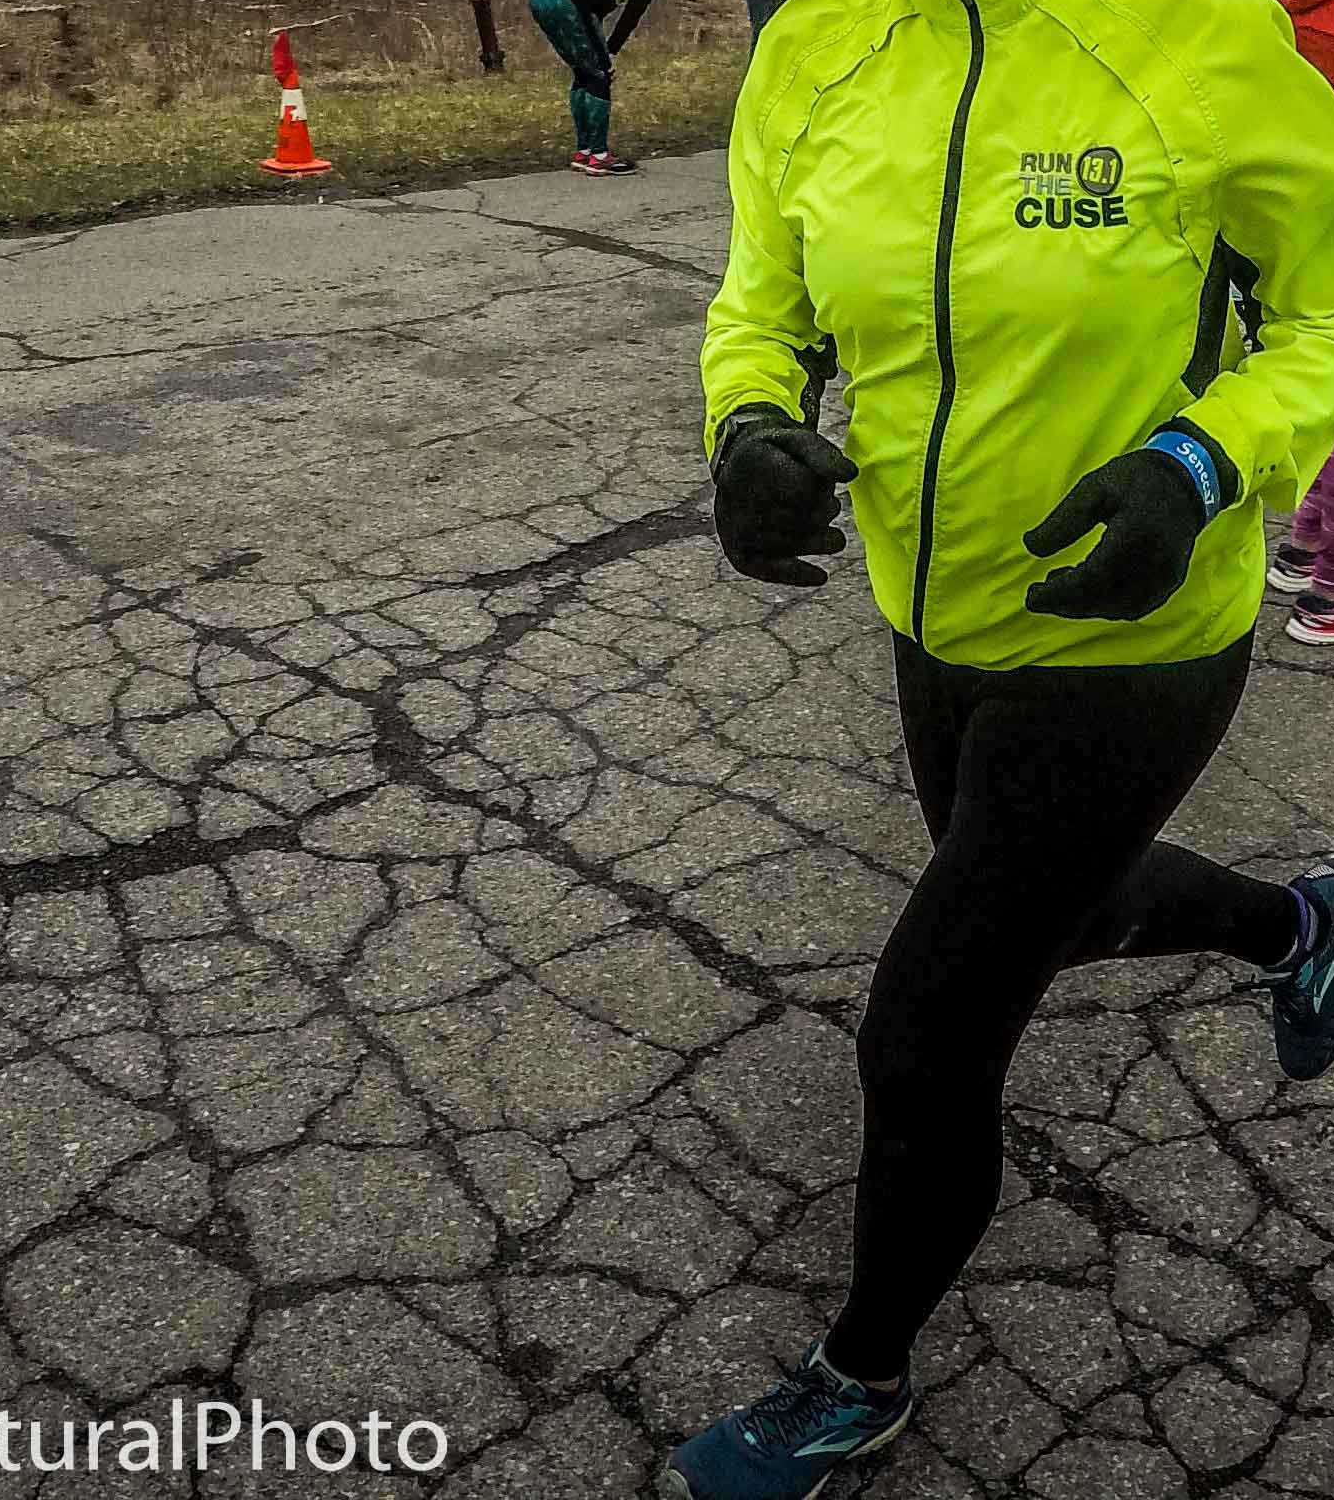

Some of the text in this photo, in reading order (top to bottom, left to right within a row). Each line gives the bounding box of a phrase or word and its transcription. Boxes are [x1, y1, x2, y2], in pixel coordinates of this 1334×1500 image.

[1020, 152, 1073, 174] RUN
[1081, 156, 1117, 184] 13.1
[1019, 176, 1073, 195] THE
[1014, 196, 1129, 229] CUSE
